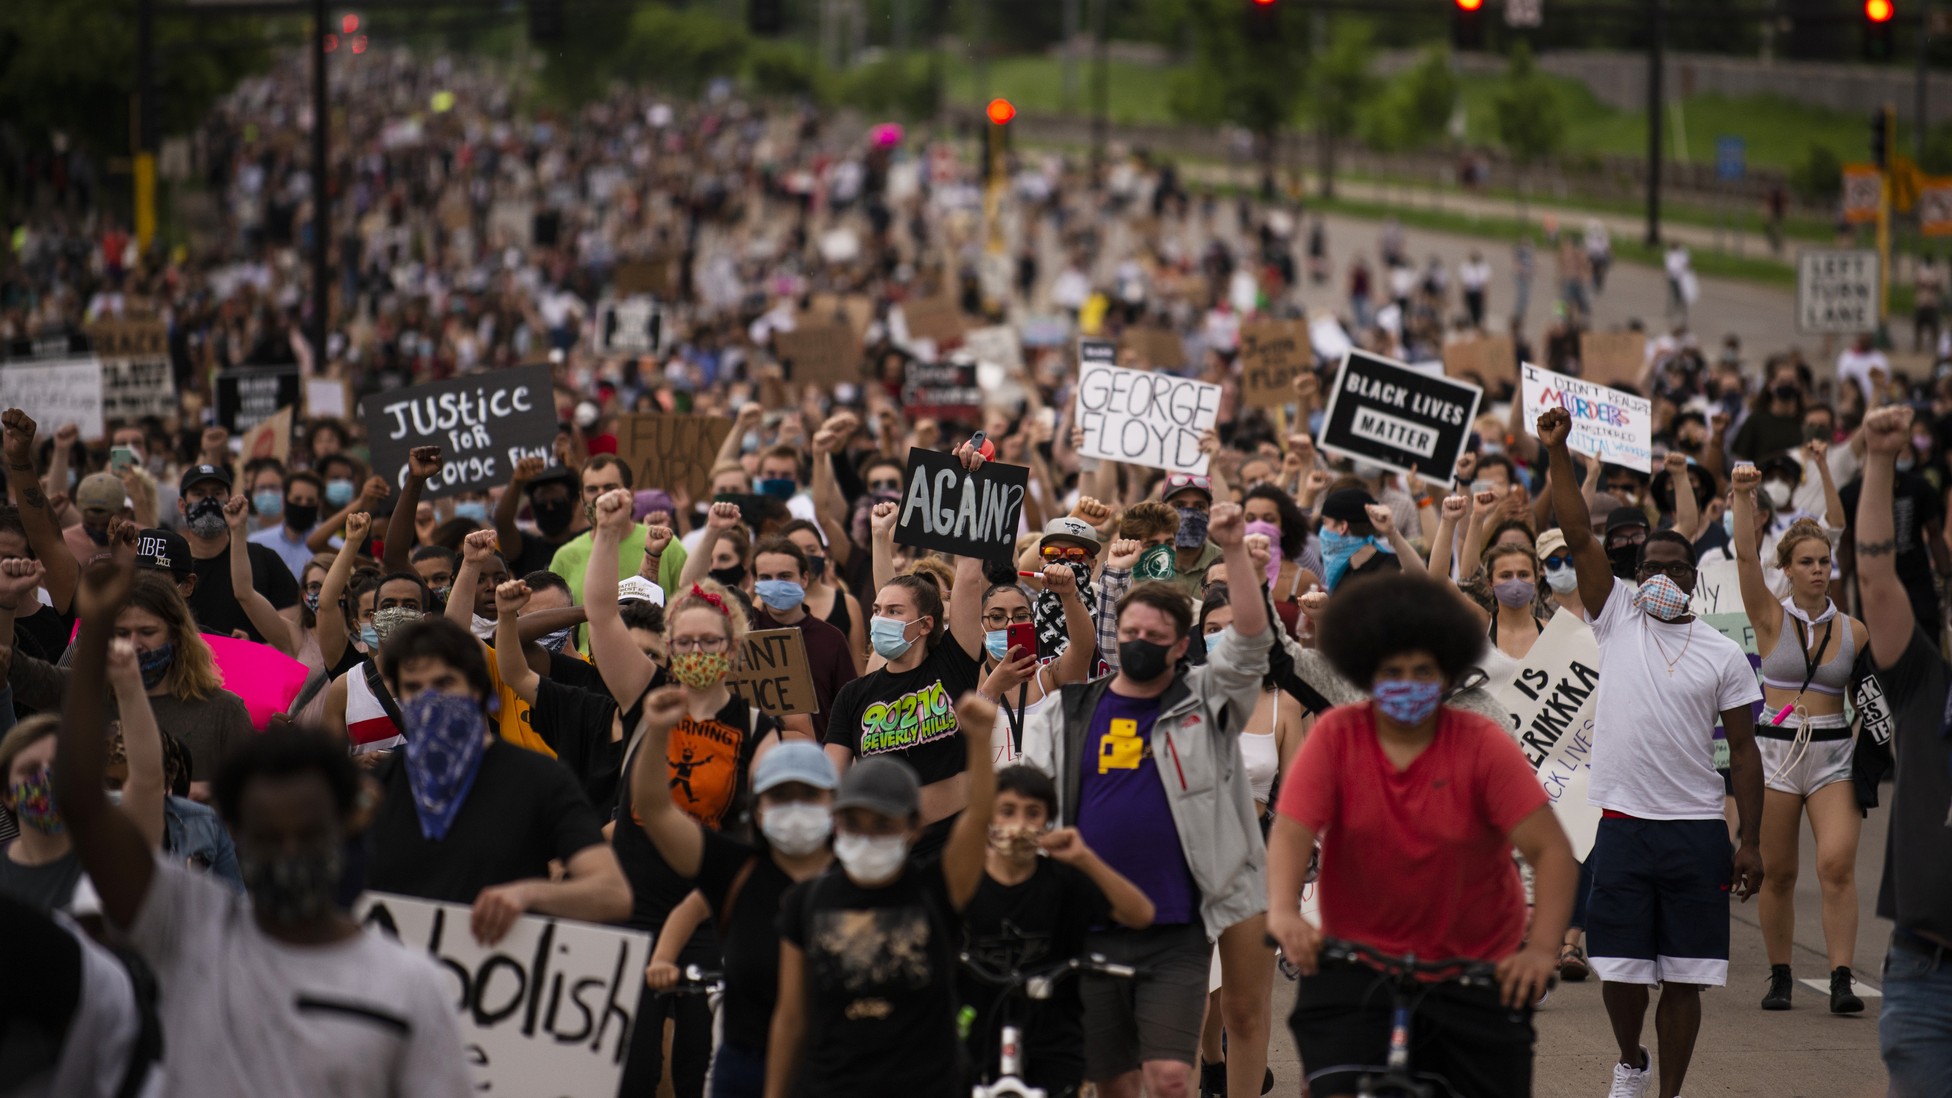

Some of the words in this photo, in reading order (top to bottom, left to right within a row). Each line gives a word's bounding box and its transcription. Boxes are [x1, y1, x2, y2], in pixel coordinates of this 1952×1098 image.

[1811, 258, 1864, 276] LEFT
[1811, 283, 1868, 299] TURN
[1807, 306, 1864, 325] LANE
[1081, 368, 1215, 431] GEORGE
[1346, 371, 1409, 409] BLACK
[1411, 393, 1464, 426] LIVES
[1525, 366, 1539, 382] I
[1554, 376, 1600, 397] DIDN'T
[1540, 387, 1630, 427] MURDERS
[631, 416, 718, 461] FUCK
[1082, 411, 1203, 468] FLOYD
[1361, 415, 1430, 451] MATTER
[900, 464, 1024, 545] AGAIN?
[738, 635, 791, 672] ANT
[725, 677, 795, 710] TICE
[1513, 668, 1549, 701] IS
[863, 682, 948, 734] 90210
[1521, 661, 1600, 775] ERIKKA
[677, 719, 732, 745] RNING
[863, 725, 919, 752] BEVERLY
[921, 712, 957, 740] HILLS
